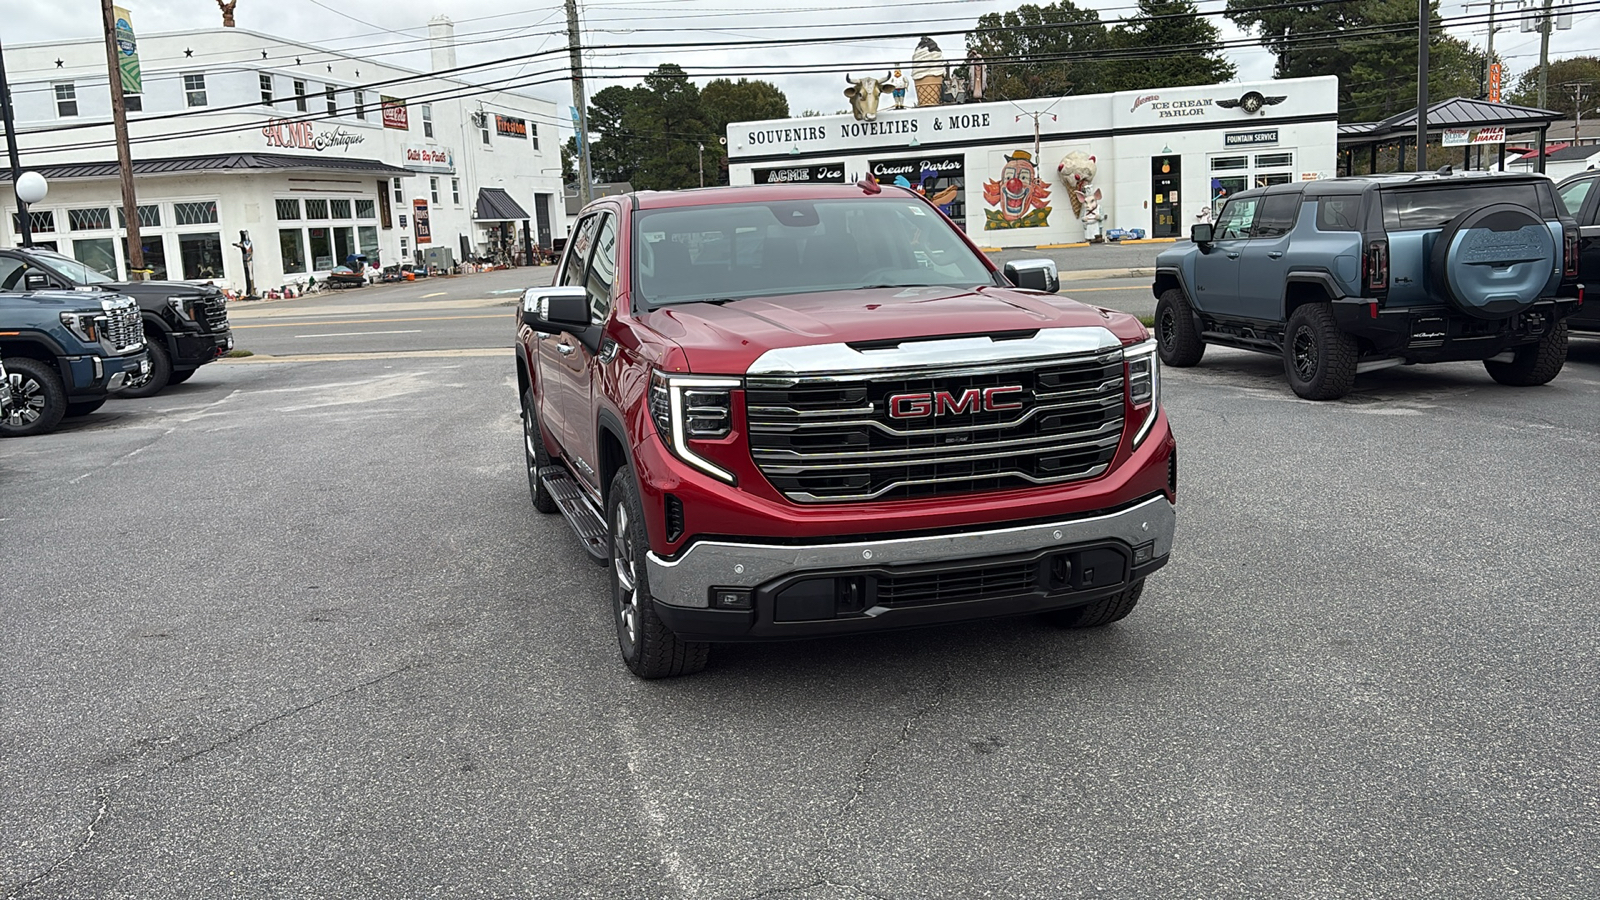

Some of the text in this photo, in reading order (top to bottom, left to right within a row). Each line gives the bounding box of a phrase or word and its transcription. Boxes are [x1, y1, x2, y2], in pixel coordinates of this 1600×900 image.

[1151, 98, 1213, 110] ICE CREAM
[1159, 107, 1205, 118] PARLOR
[262, 116, 315, 149] ACME
[749, 113, 990, 144] SOUVENIRS NOVELTIES & MORE
[1480, 126, 1504, 135] MILK
[1227, 131, 1277, 143] FOUNTAIN SERVICE
[1474, 134, 1503, 143] SHAKES
[874, 159, 962, 175] Cream Parlor
[768, 167, 843, 183] ACME Ice
[889, 385, 1023, 419] GMC
